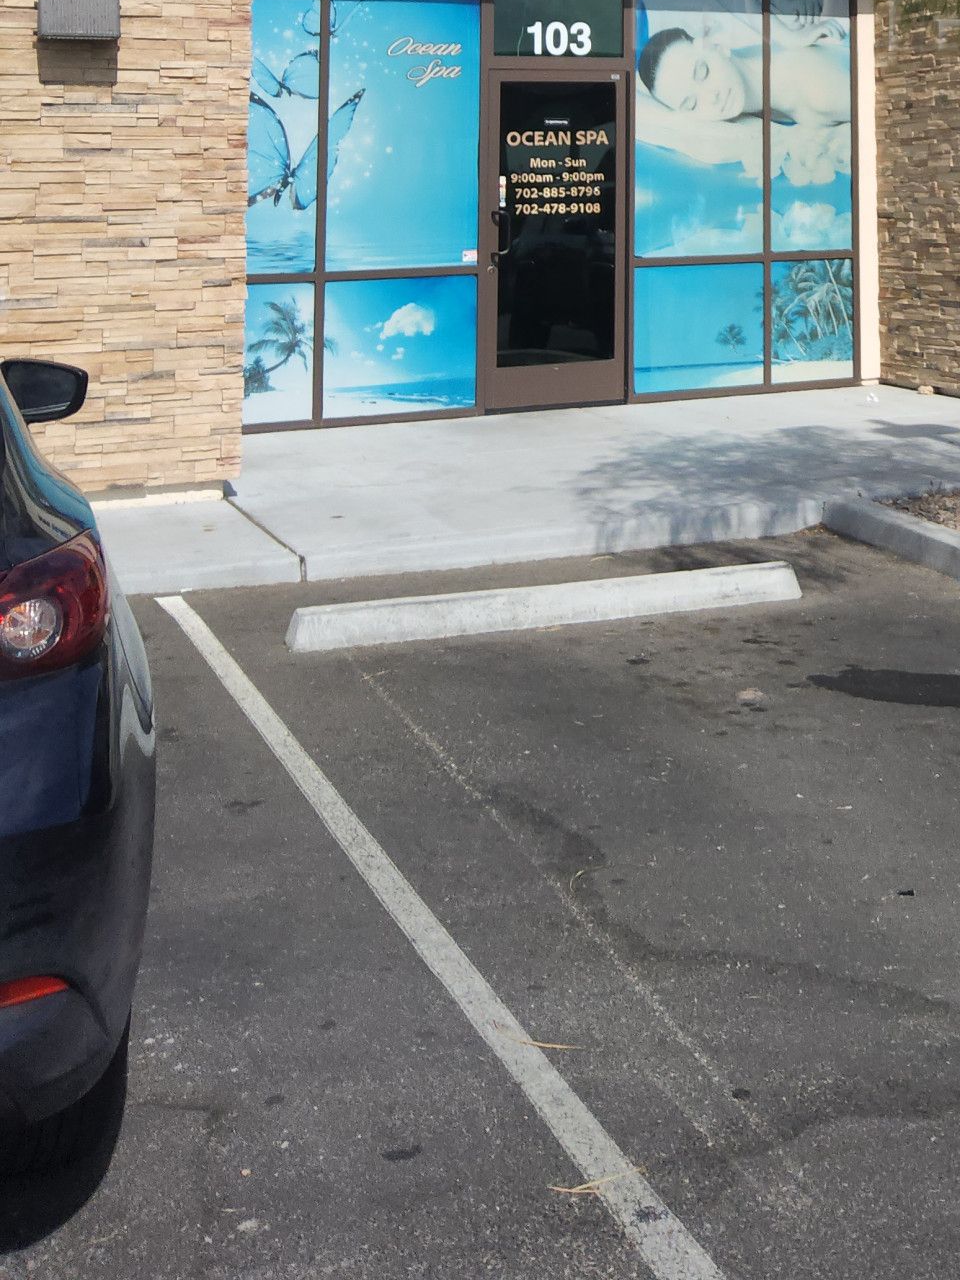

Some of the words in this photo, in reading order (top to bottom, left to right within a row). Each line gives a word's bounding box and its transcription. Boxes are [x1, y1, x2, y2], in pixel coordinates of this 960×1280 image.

[387, 36, 462, 56] Ocean
[526, 21, 592, 56] 103
[406, 59, 462, 88] Spa
[506, 130, 572, 147] OCEAN
[575, 130, 609, 146] SPA
[529, 157, 557, 169] Mon
[564, 157, 587, 168] Sun
[510, 172, 554, 184] 9:00am
[562, 172, 605, 184] 9:00pm
[514, 202, 602, 215] 702-478-9108
